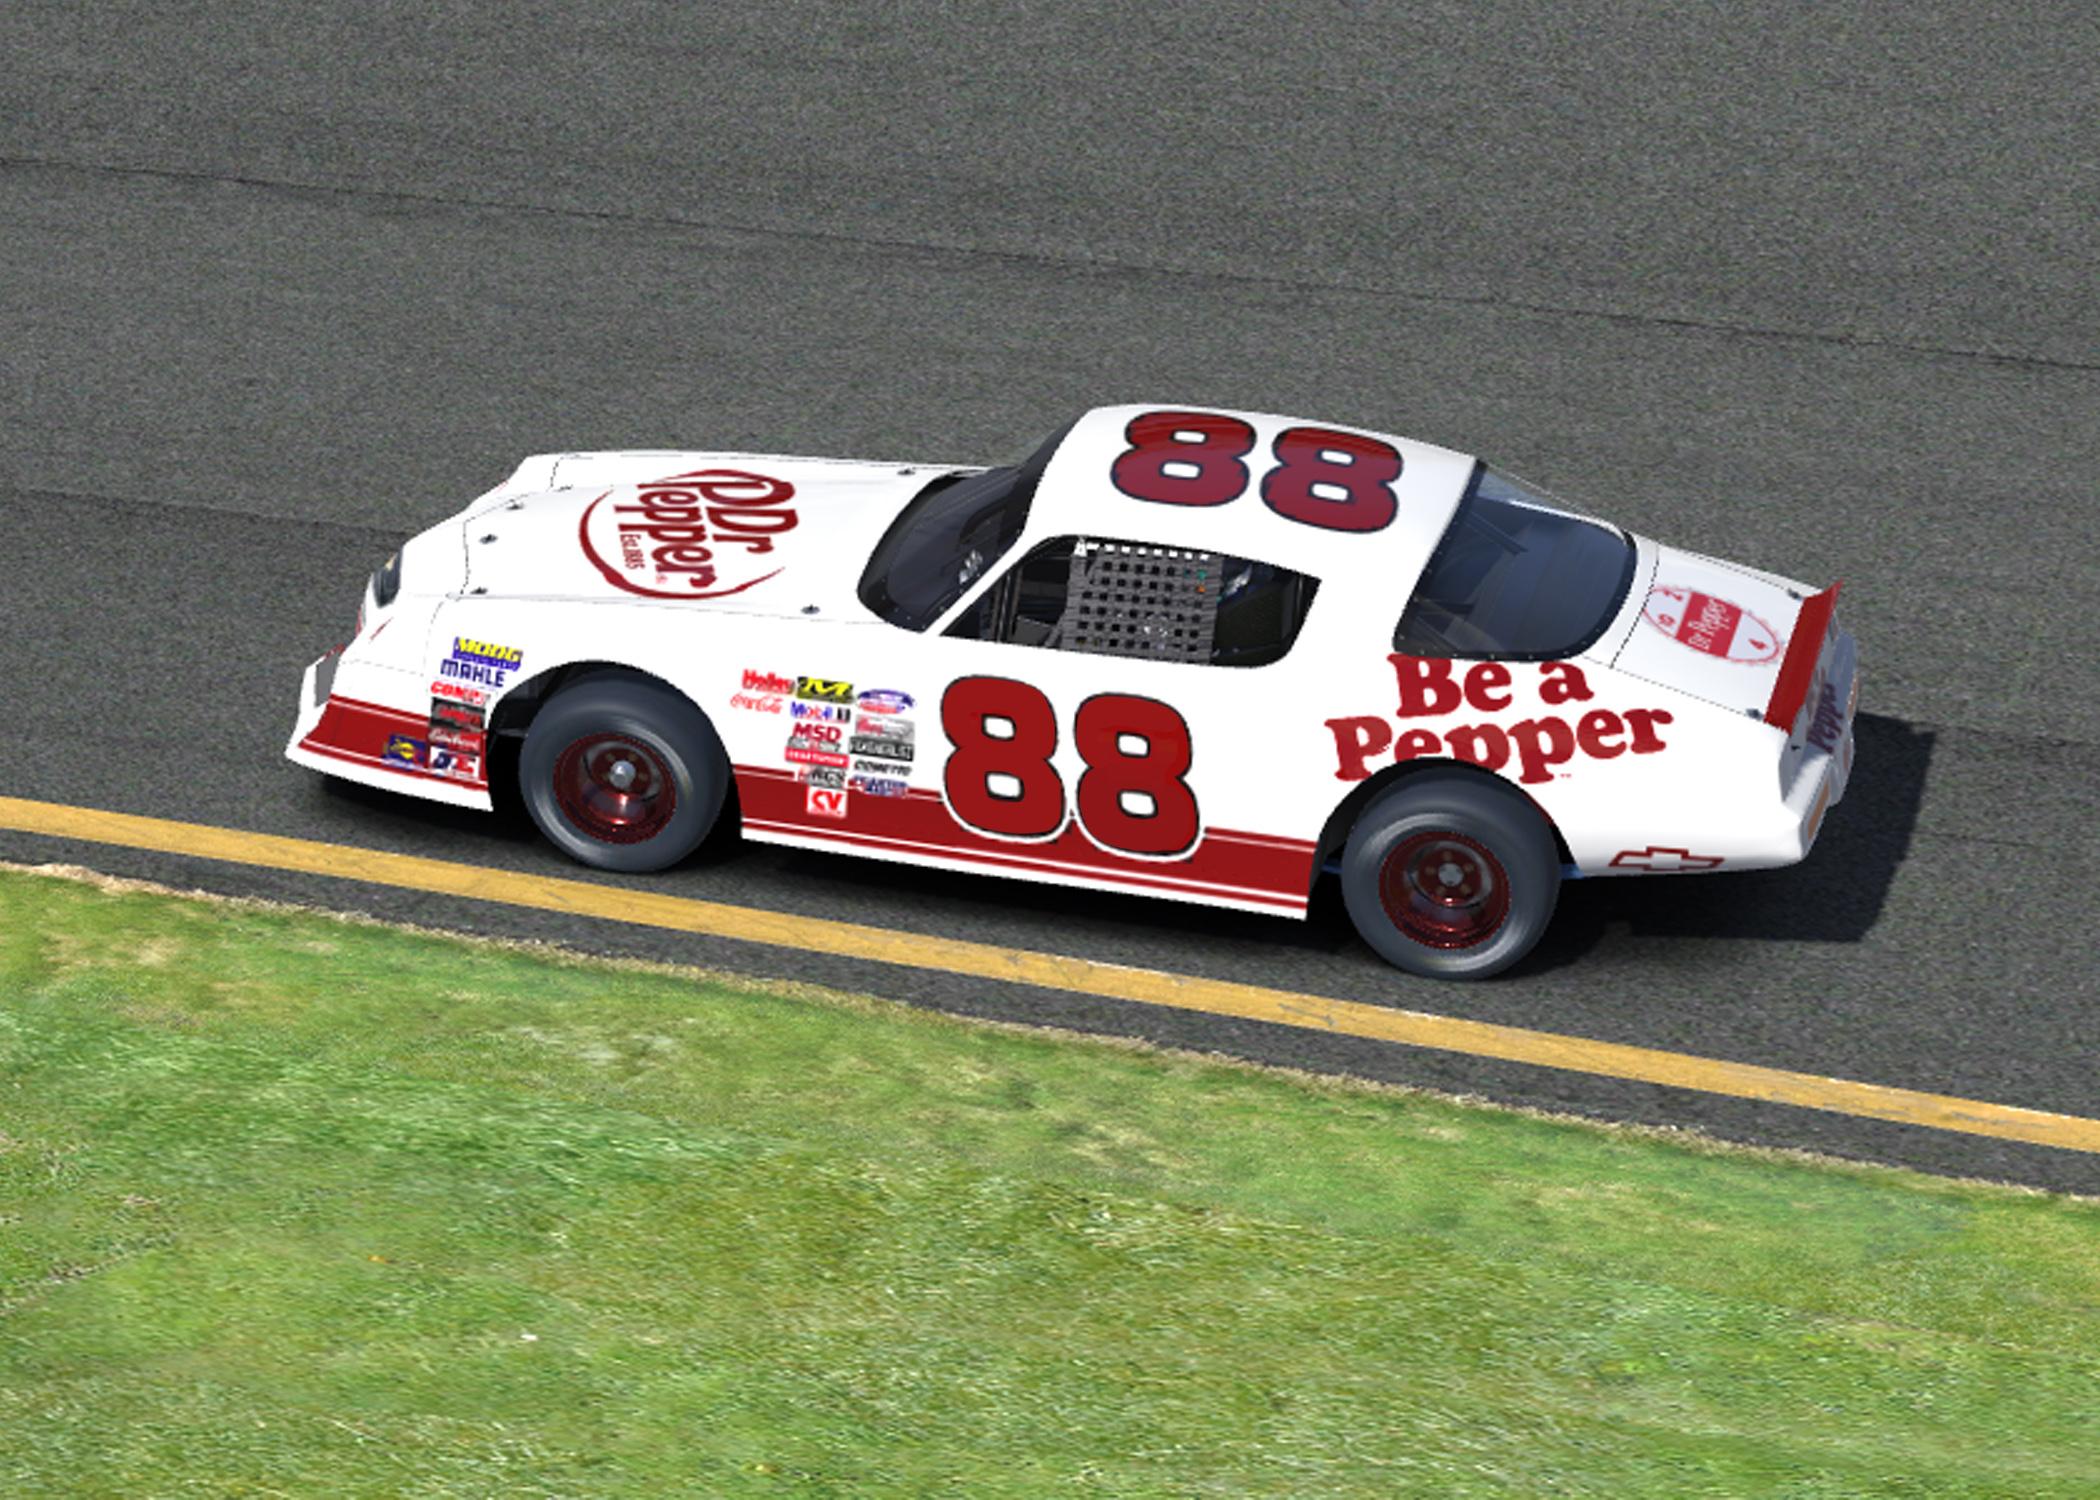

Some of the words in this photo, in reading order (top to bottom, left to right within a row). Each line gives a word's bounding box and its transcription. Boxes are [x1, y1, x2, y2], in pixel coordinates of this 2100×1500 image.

[1110, 411, 1403, 534] 88
[613, 480, 796, 588] Pepper
[705, 506, 799, 554] Dr
[440, 658, 506, 687] MAHLE
[1387, 653, 1513, 719] Be
[1538, 661, 1595, 705] a
[792, 722, 842, 744] MSD
[940, 674, 1200, 857] 88
[1324, 708, 1674, 784] Pepper
